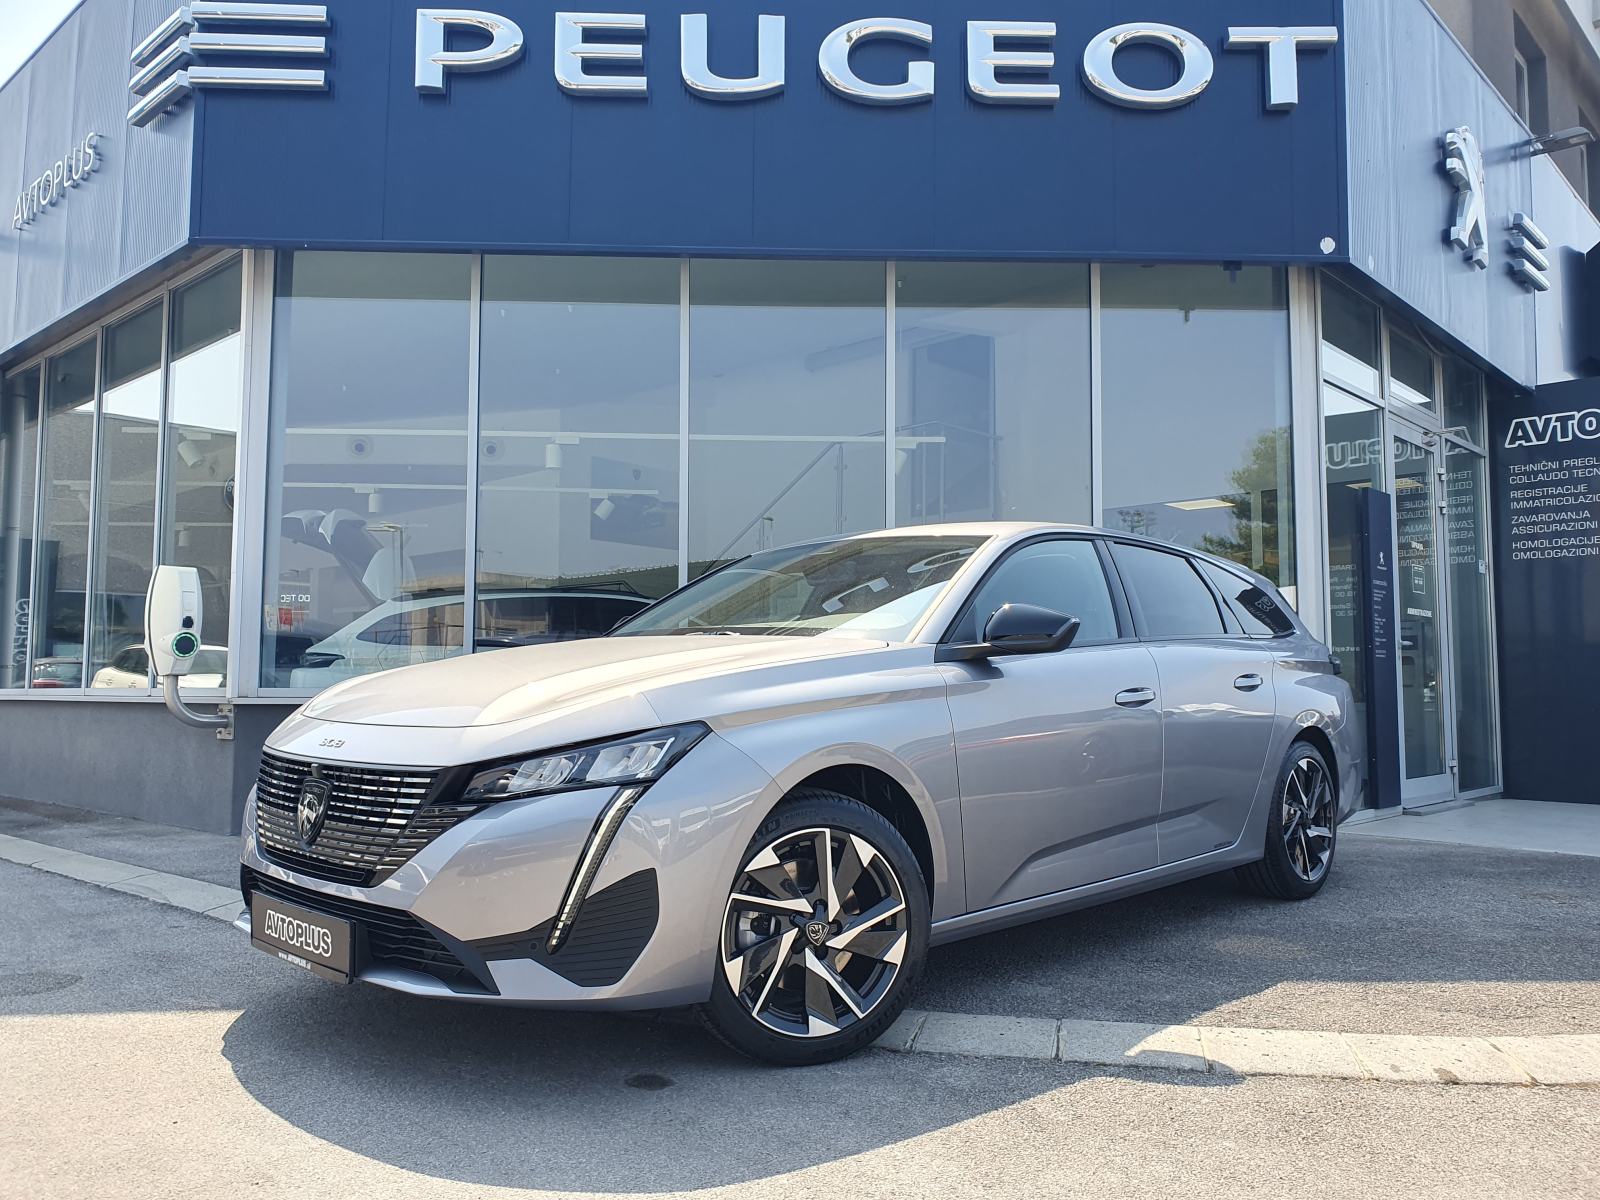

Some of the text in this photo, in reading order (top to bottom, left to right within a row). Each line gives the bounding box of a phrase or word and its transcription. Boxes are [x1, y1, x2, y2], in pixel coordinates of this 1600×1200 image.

[414, 8, 1338, 111] PEUGEOT
[12, 131, 97, 230] AVTOPLUS
[1504, 408, 1600, 449] AVTO
[1509, 460, 1560, 474] TEHNIČNI
[1509, 470, 1569, 485] COLLAUDO
[1510, 483, 1589, 499] REGISTRACIJE
[1511, 510, 1591, 525] ZAVAROVANJA
[1511, 520, 1598, 536] ASSICURAZIONI
[1512, 535, 1600, 550] HOMOLOGACIJE
[1512, 546, 1600, 561] OMOLOGAZIONI
[264, 909, 332, 957] AVTOPLUS
